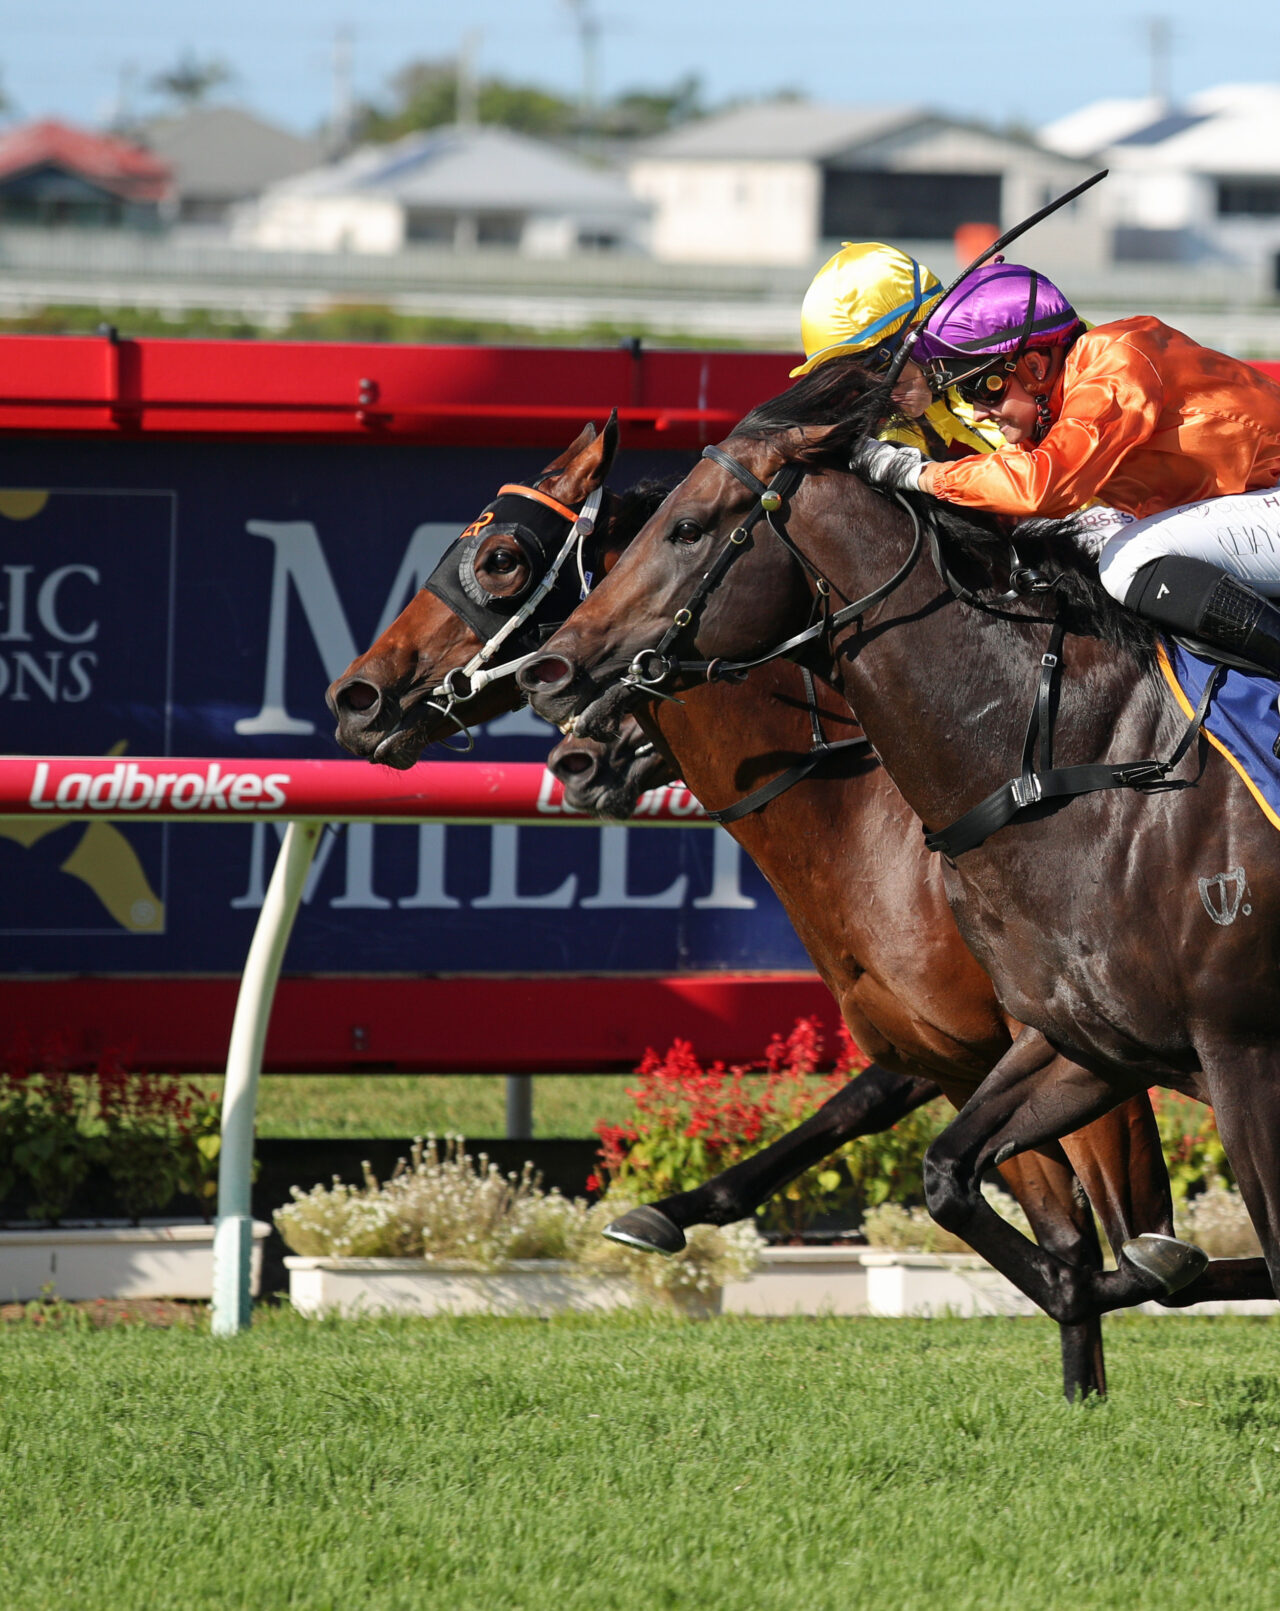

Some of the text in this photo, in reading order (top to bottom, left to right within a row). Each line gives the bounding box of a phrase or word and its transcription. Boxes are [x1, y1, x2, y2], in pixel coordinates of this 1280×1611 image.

[0, 564, 99, 644] IC
[0, 650, 98, 703] NS
[29, 762, 292, 811] Ladbrokes
